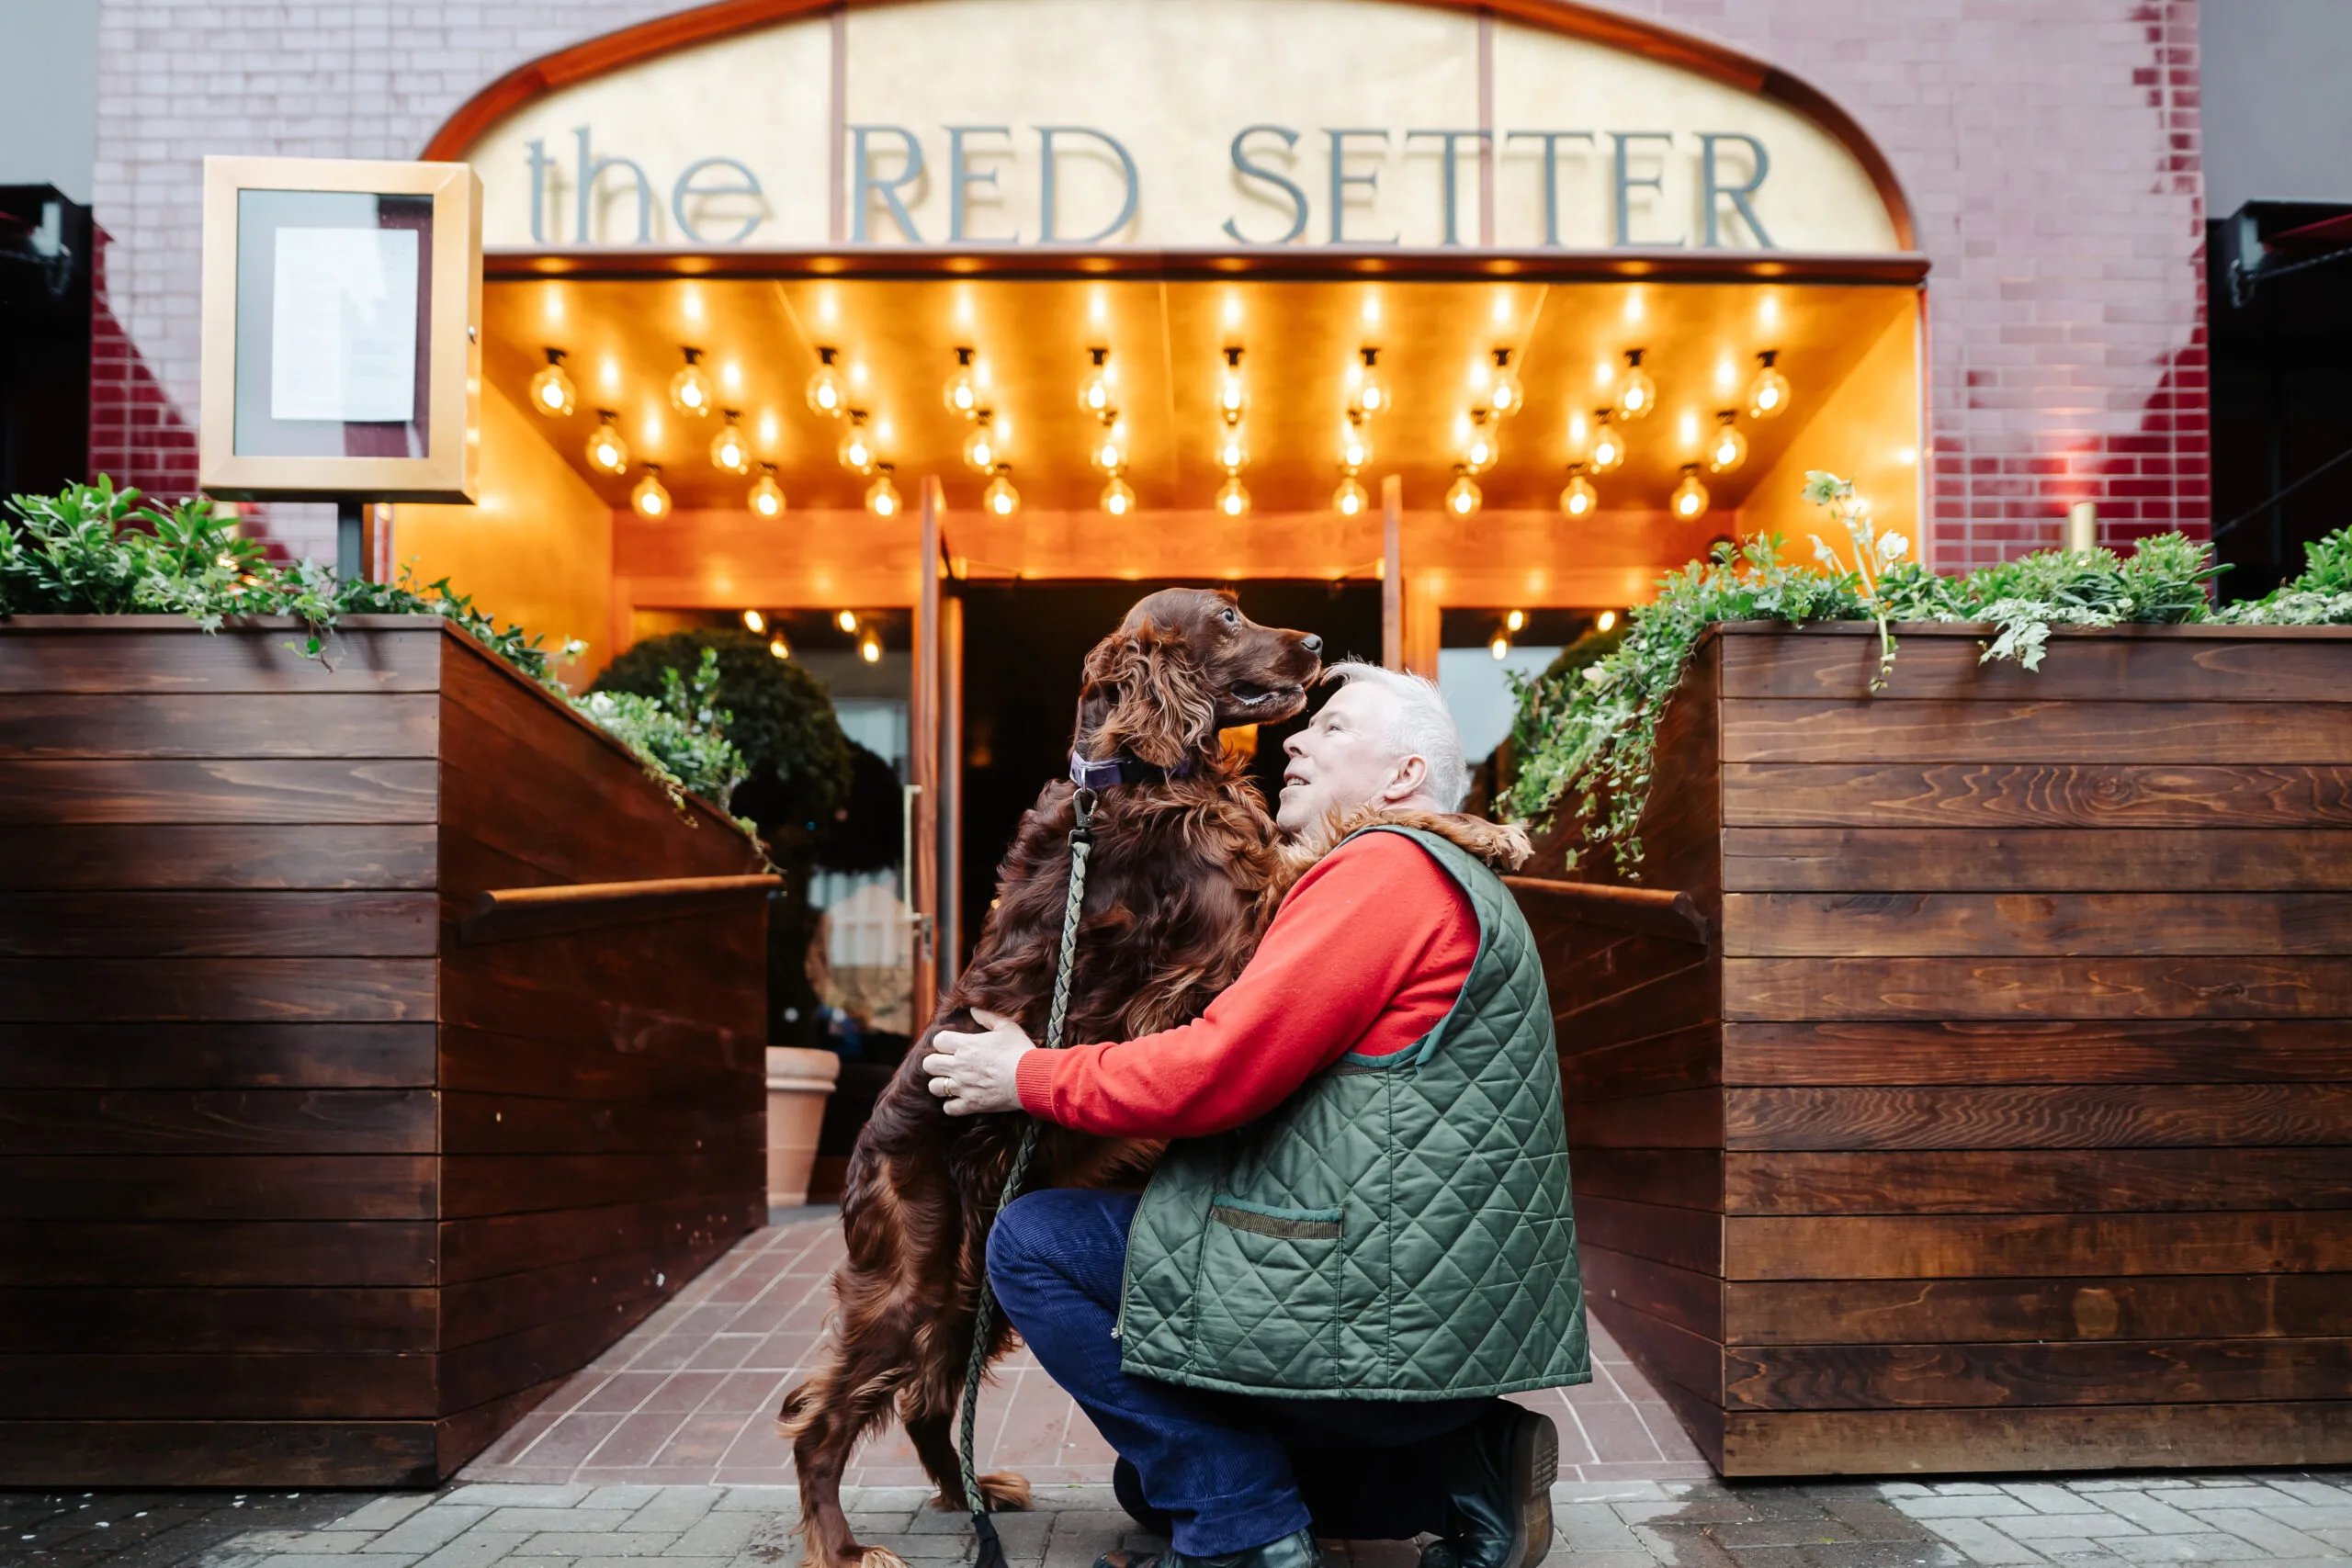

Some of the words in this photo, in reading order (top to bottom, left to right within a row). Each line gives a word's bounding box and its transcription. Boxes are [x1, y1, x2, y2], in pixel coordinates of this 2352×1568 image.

[524, 125, 764, 245] the
[844, 125, 1139, 244] RED
[1221, 125, 1779, 248] SETTER
